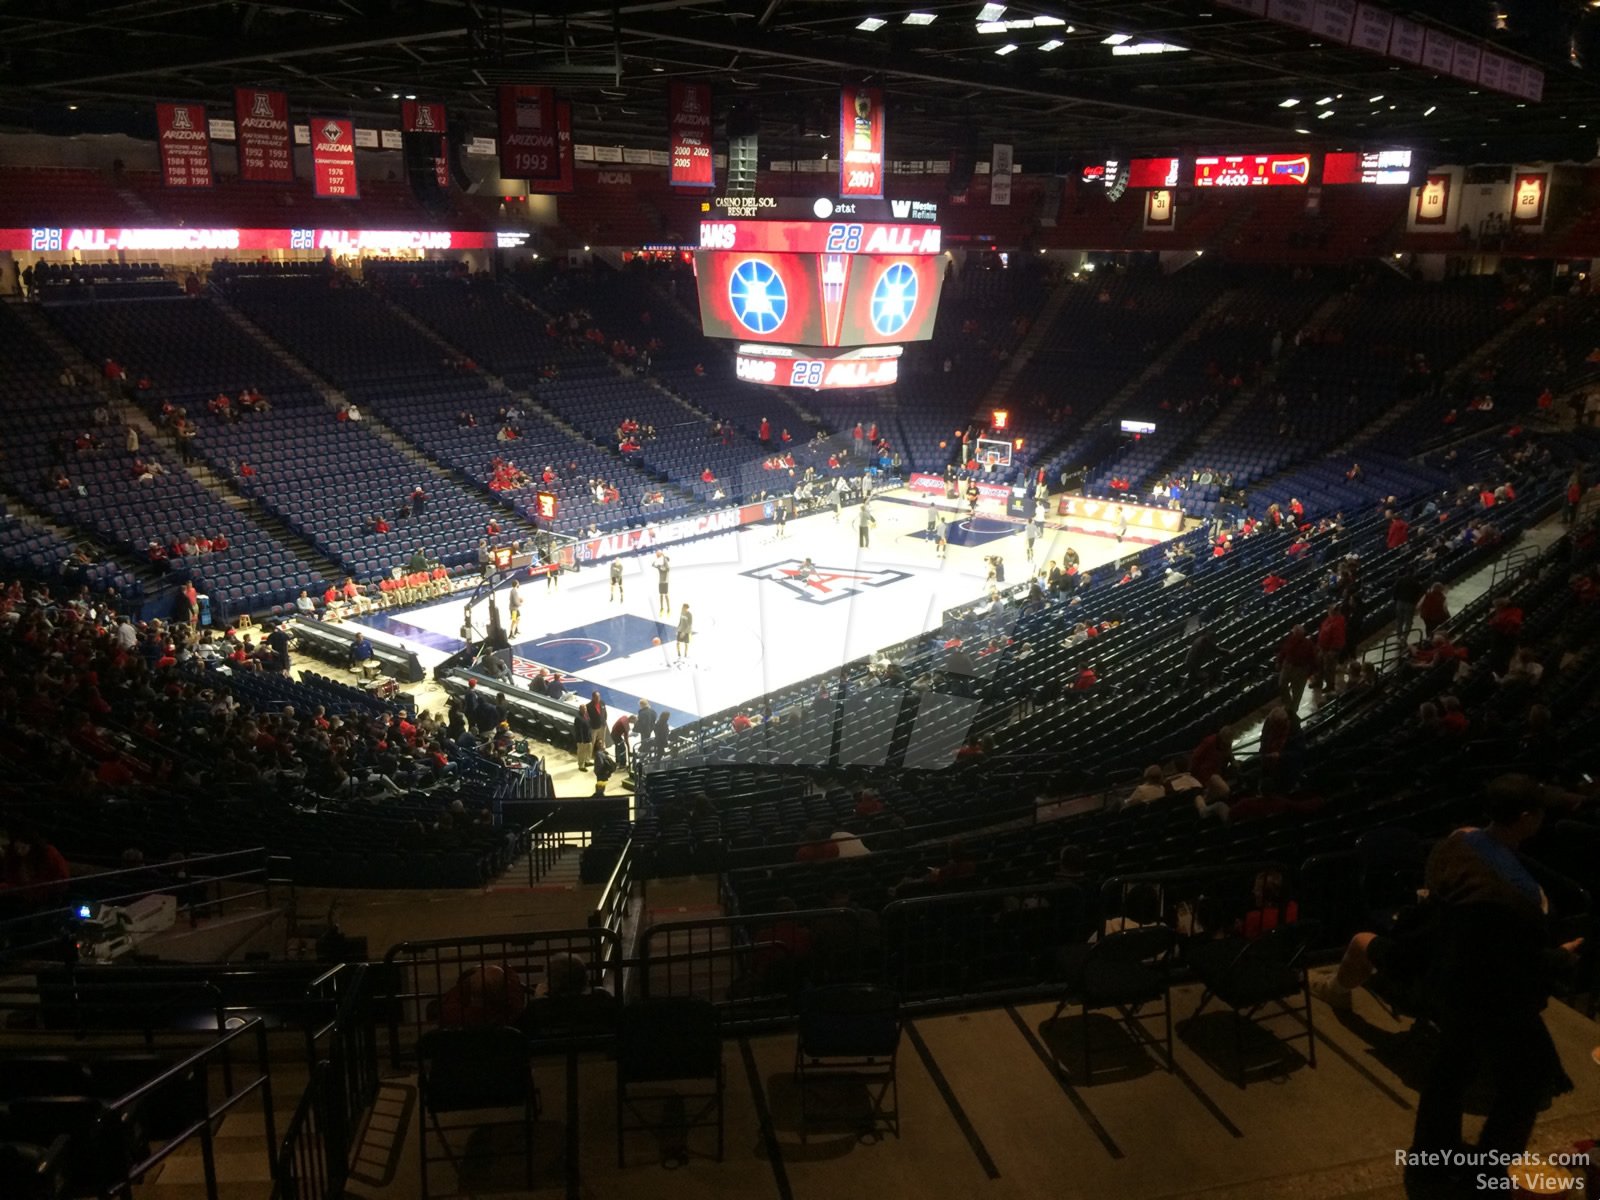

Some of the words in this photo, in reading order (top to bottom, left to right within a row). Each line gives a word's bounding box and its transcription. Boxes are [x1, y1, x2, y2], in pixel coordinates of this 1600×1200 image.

[242, 118, 288, 130] ARIZONA
[673, 113, 710, 126] ARIZONA
[163, 130, 207, 140] ARIZONA
[506, 134, 554, 146] ARIZONA
[245, 147, 263, 157] 1992
[269, 149, 287, 158] 1993
[315, 143, 353, 153] ARIZONA
[674, 146, 691, 156] 2000
[693, 147, 710, 157] 2002
[246, 158, 265, 168] 1996
[269, 160, 288, 169] 2002
[514, 153, 548, 170] 1993
[674, 158, 691, 167] 2005
[597, 171, 632, 185] NCAA
[848, 170, 875, 187] 2001
[1216, 174, 1249, 186] 44:00
[329, 186, 345, 194] 1978
[716, 197, 740, 207] CASINO
[742, 198, 758, 208] DEL
[759, 198, 777, 208] SOL
[1157, 200, 1165, 208] 31
[1428, 195, 1438, 205] 10
[1522, 195, 1535, 205] 22
[728, 206, 758, 217] RESORT
[835, 203, 856, 213] at&t
[32, 229, 62, 250] 28
[291, 229, 315, 249] 28
[319, 230, 451, 249] ALL-AMERICANS
[826, 223, 864, 253] 28
[790, 360, 824, 386] 28
